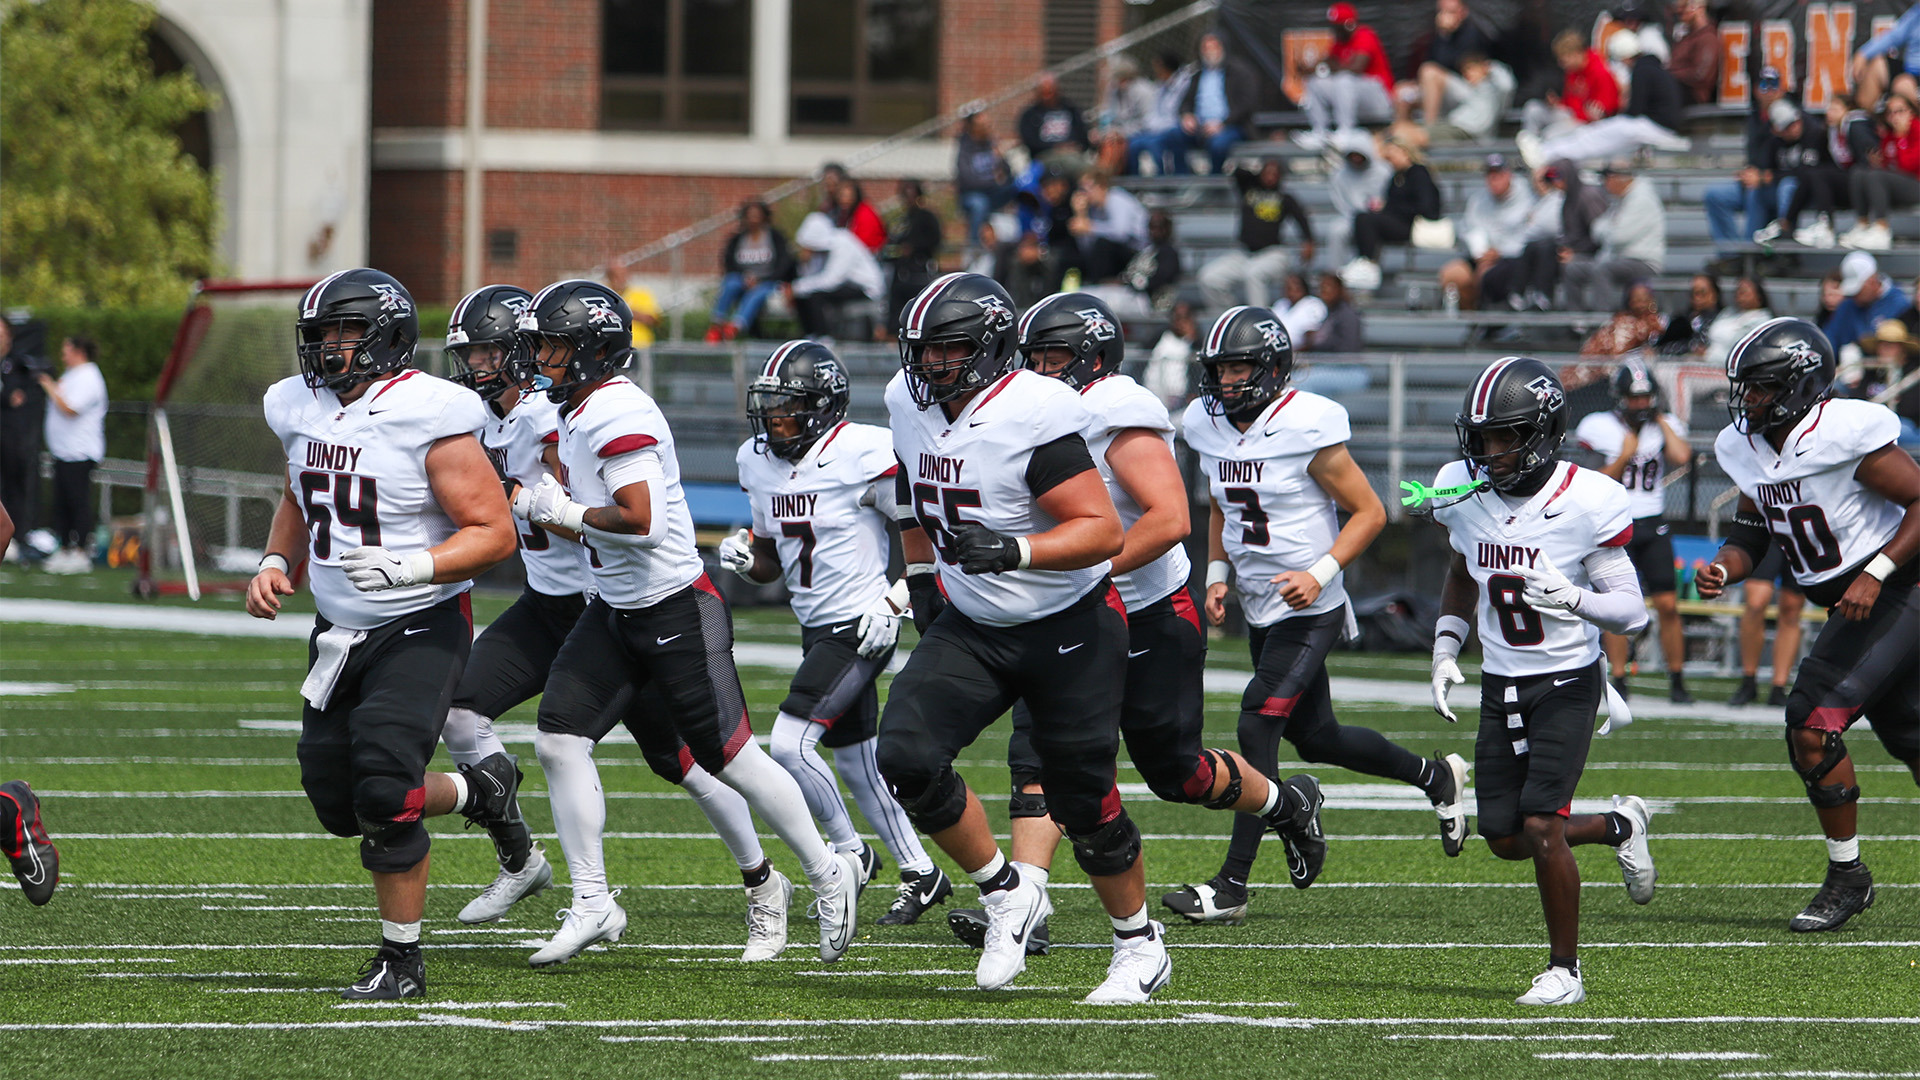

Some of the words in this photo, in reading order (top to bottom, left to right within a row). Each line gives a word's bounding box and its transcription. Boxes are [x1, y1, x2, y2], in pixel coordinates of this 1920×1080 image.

[306, 441, 362, 472] UINDY
[919, 452, 964, 484] UINDY
[1218, 461, 1264, 483] UINDY
[771, 493, 818, 518] UINDY
[1757, 480, 1802, 506] UINDY
[299, 471, 382, 560] 64
[1224, 487, 1270, 547] 3
[780, 520, 817, 589] 7
[1477, 542, 1541, 570] UINDY
[1487, 573, 1545, 647] 8
